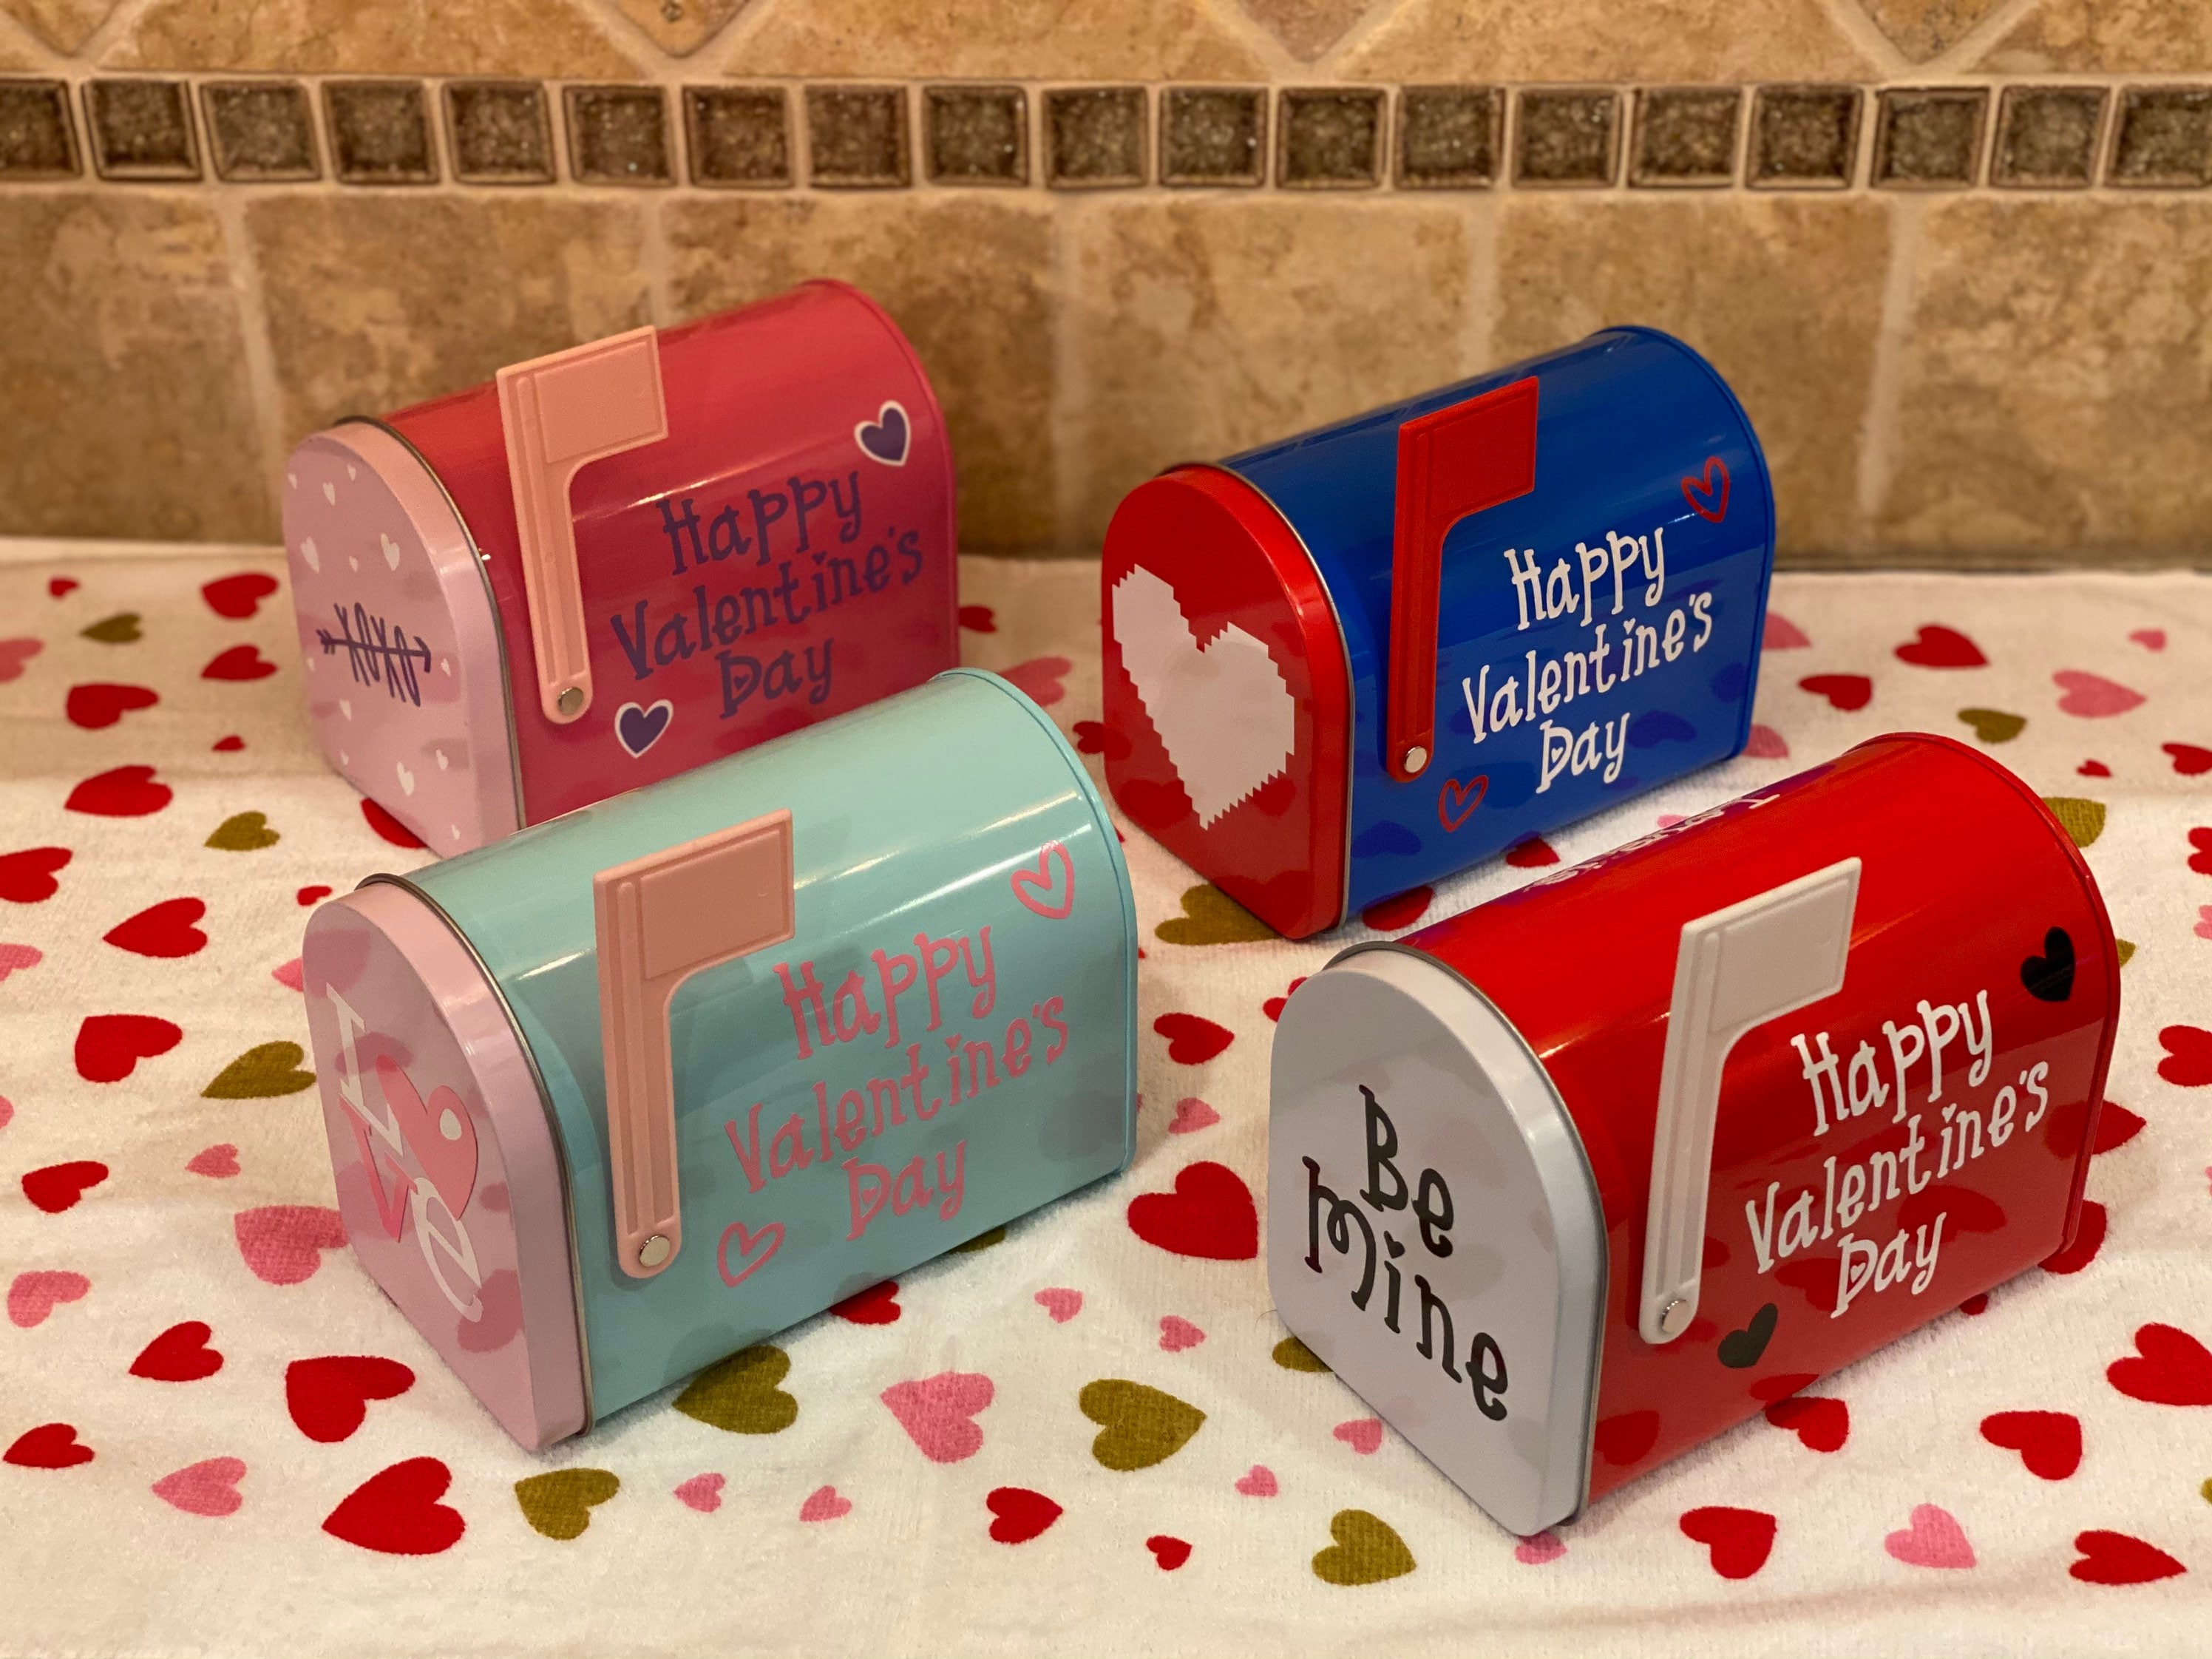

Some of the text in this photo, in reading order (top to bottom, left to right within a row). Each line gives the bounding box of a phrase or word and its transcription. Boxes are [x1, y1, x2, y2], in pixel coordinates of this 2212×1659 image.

[657, 472, 861, 574] Happy
[1504, 527, 1666, 631] Happy
[333, 603, 421, 706] XOXO
[611, 528, 923, 679] Valentine's
[1462, 594, 1713, 744] Valentine's
[716, 639, 833, 719] Day
[1536, 713, 1630, 793] Day
[773, 926, 997, 1060] Happy
[725, 996, 1069, 1193] Valentine's
[1791, 990, 1992, 1136] Happy
[840, 1140, 967, 1240] Day
[1359, 1085, 1454, 1257] Be
[1745, 1062, 2049, 1274] Valentine's
[1301, 1155, 1510, 1422] Mine
[1831, 1214, 1947, 1318] Day
